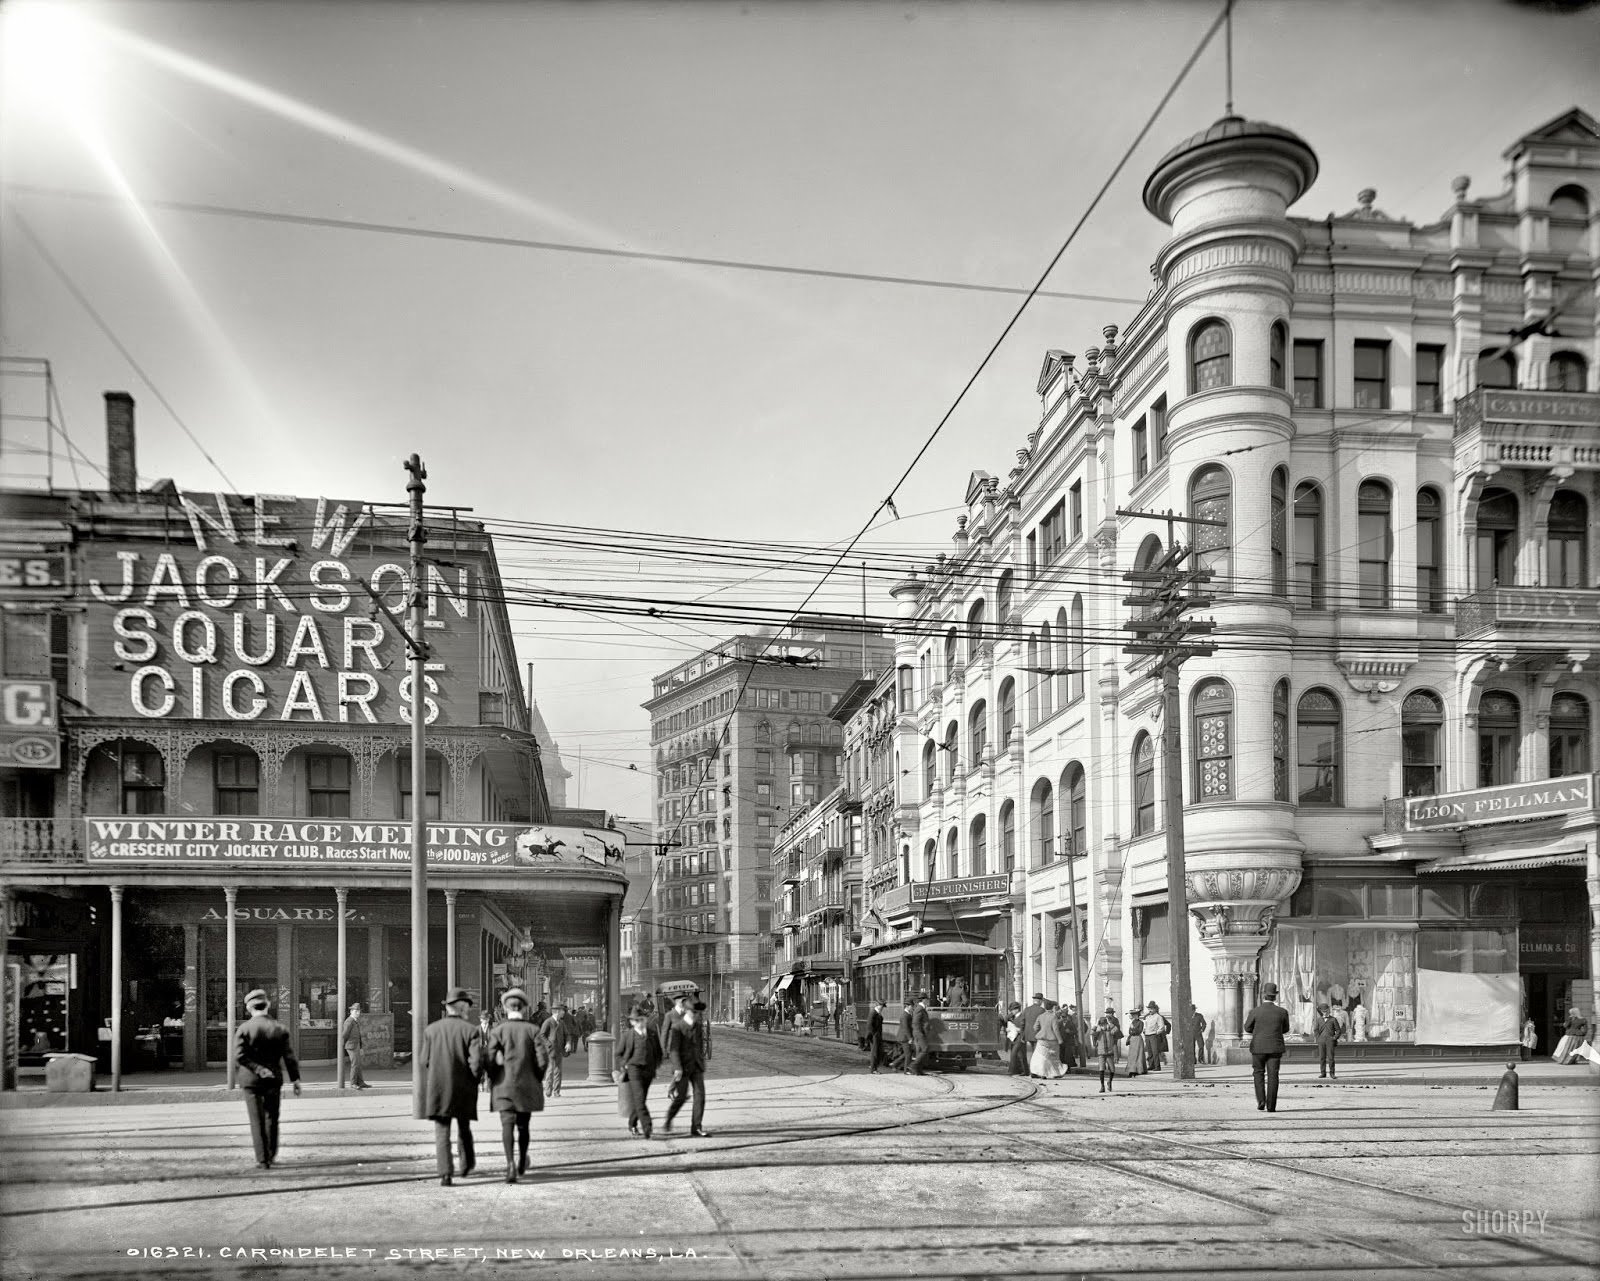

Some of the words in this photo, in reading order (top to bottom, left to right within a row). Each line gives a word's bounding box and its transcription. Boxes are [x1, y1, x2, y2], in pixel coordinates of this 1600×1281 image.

[181, 492, 366, 557] NEW
[90, 552, 468, 617] JACKSON
[131, 665, 440, 725] CIGARS
[1413, 802, 1467, 820] LEON
[91, 821, 242, 841] WINTER
[249, 822, 342, 842] RACE
[109, 843, 183, 857] CRESCENT
[186, 844, 220, 857] CITY
[223, 844, 279, 858] JOCKEY
[283, 845, 323, 859] CLUB,
[326, 846, 358, 859] Races
[360, 846, 387, 859] Start
[390, 847, 411, 860] Nov.
[443, 848, 462, 861] 100
[463, 850, 487, 864] Days
[492, 852, 512, 865] MORE.
[942, 879, 1007, 895] FURNISHERS
[1519, 943, 1554, 953] ELLMAN
[1555, 944, 1562, 953] &
[948, 1022, 980, 1031] 255
